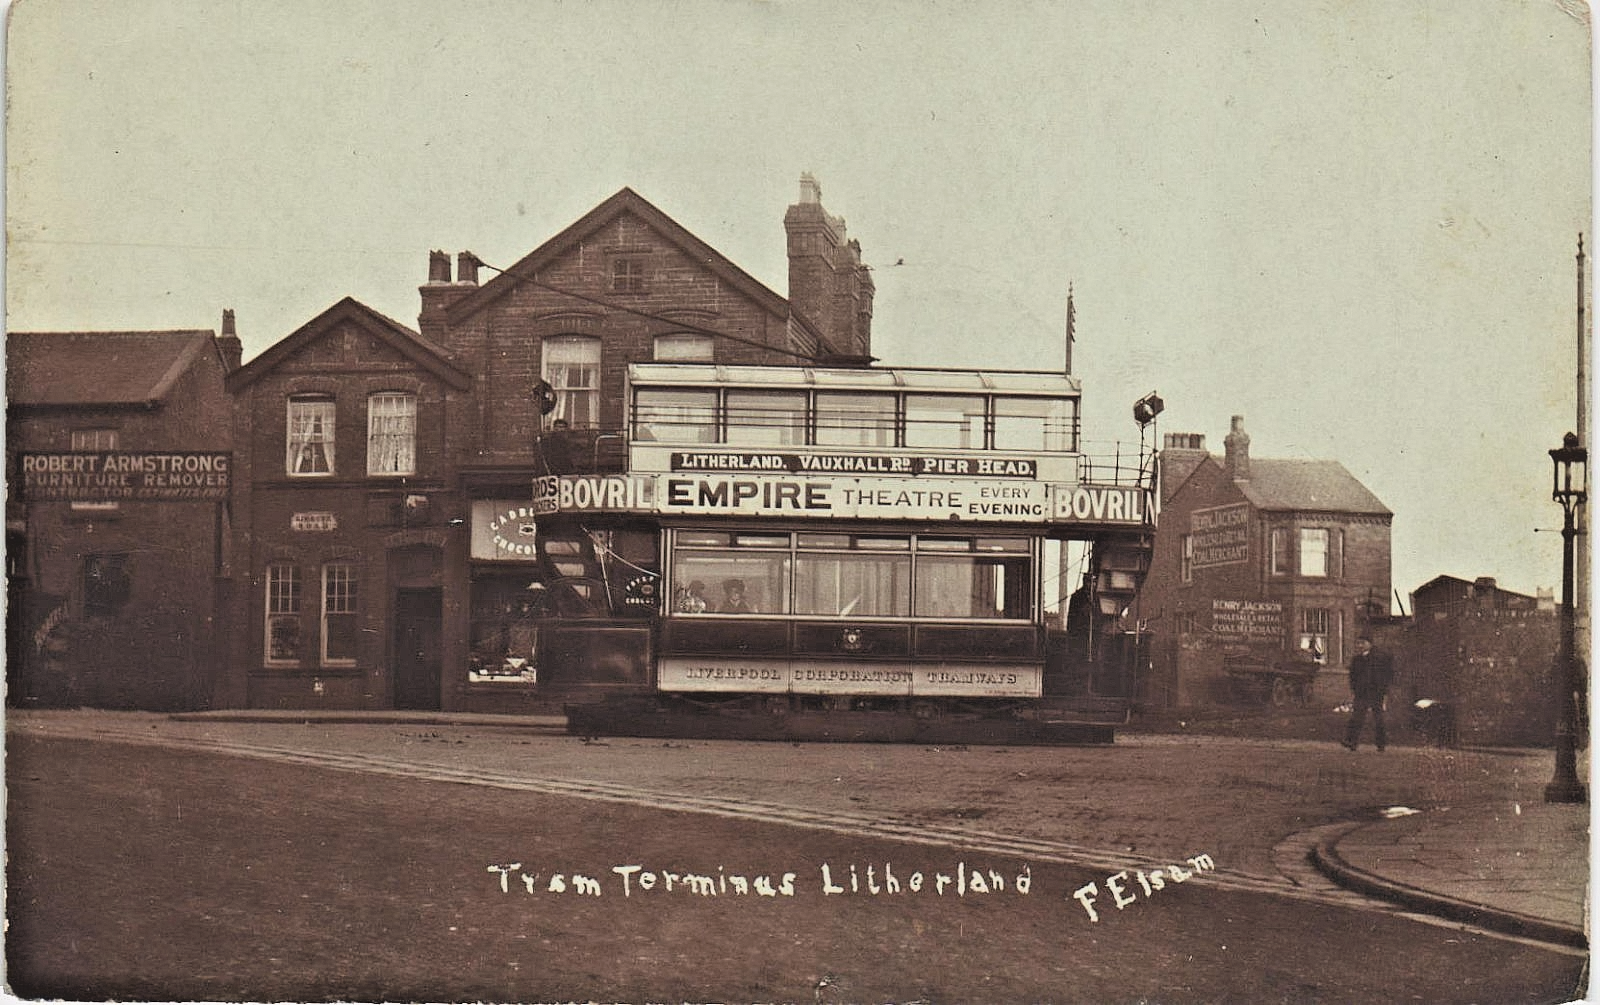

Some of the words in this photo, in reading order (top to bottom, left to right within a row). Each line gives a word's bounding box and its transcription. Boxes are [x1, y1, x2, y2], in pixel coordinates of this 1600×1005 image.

[23, 455, 98, 472] ROBERT
[103, 455, 226, 472] ARMSTRONG
[680, 454, 788, 470] LITHERLAND.
[798, 455, 888, 472] VAUXHALL
[922, 458, 969, 474] PIER
[976, 459, 1035, 476] HEAD.
[24, 472, 131, 486] FURNITURE
[144, 472, 229, 486] REMOVER
[560, 478, 651, 509] BOVRIL
[667, 479, 832, 510] EMPIRE
[843, 489, 963, 508] THEATRE
[980, 487, 1031, 499] EVERY
[968, 503, 1042, 515] EVENING
[1055, 487, 1142, 521] BOVRIL
[1213, 599, 1240, 610] HENRY
[1241, 601, 1282, 612] JACKSON
[686, 667, 784, 681] LIVERPOOL
[793, 669, 913, 683] CORPORATION
[928, 671, 1017, 685] TRAMWAYS
